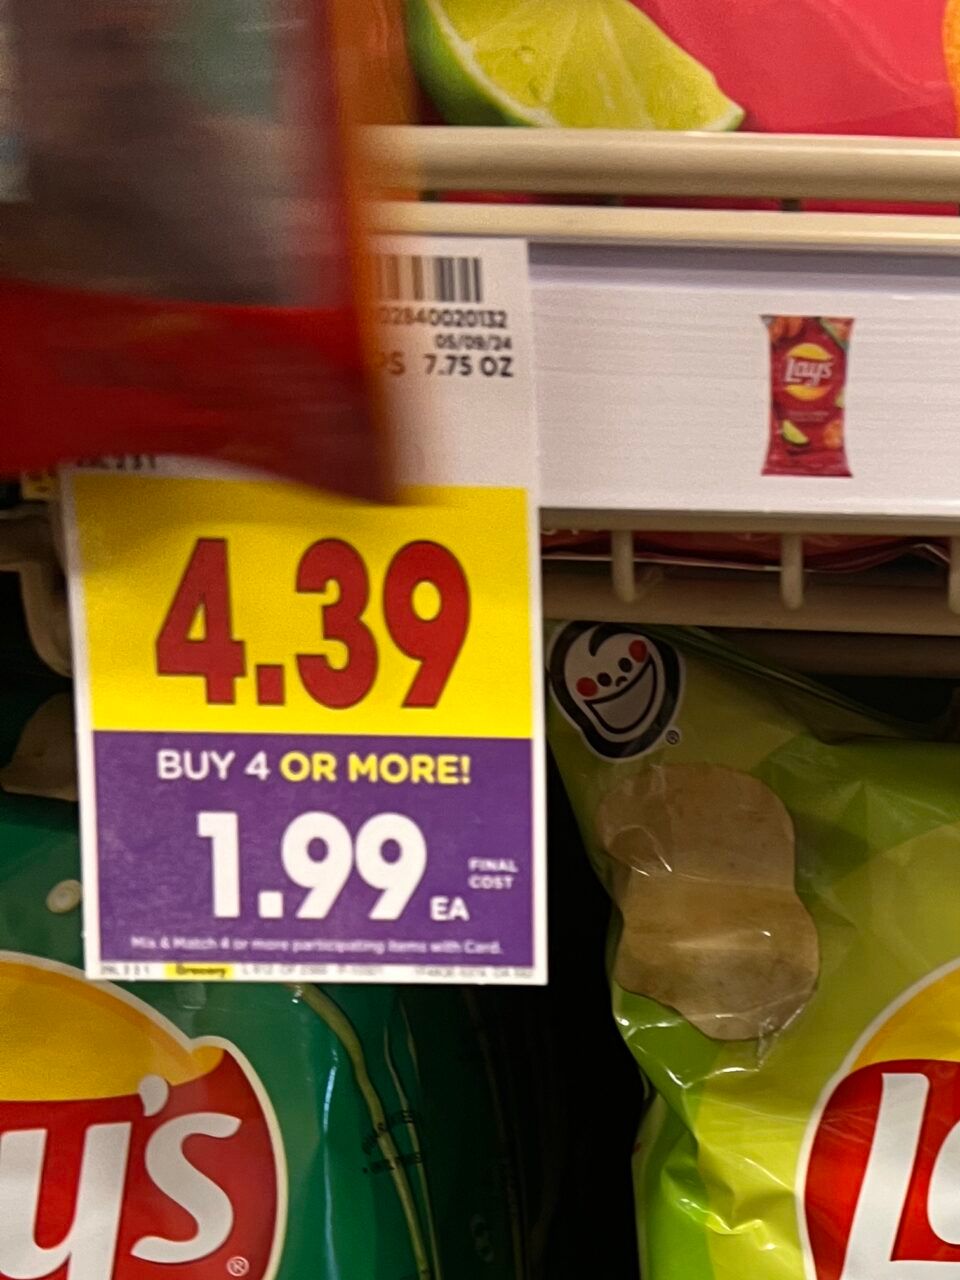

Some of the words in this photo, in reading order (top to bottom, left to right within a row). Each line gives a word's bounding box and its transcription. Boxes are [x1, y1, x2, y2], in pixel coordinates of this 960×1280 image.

[423, 353, 473, 376] 7.75
[480, 356, 513, 377] OZ
[154, 536, 472, 710] 4.39
[156, 749, 235, 781] BUY
[245, 751, 271, 781] 4
[279, 752, 338, 783] OR
[347, 754, 472, 786] MORE!
[196, 810, 428, 921] 1.99
[430, 896, 470, 922] EA
[467, 856, 519, 874] FINAL
[467, 874, 515, 891] COST
